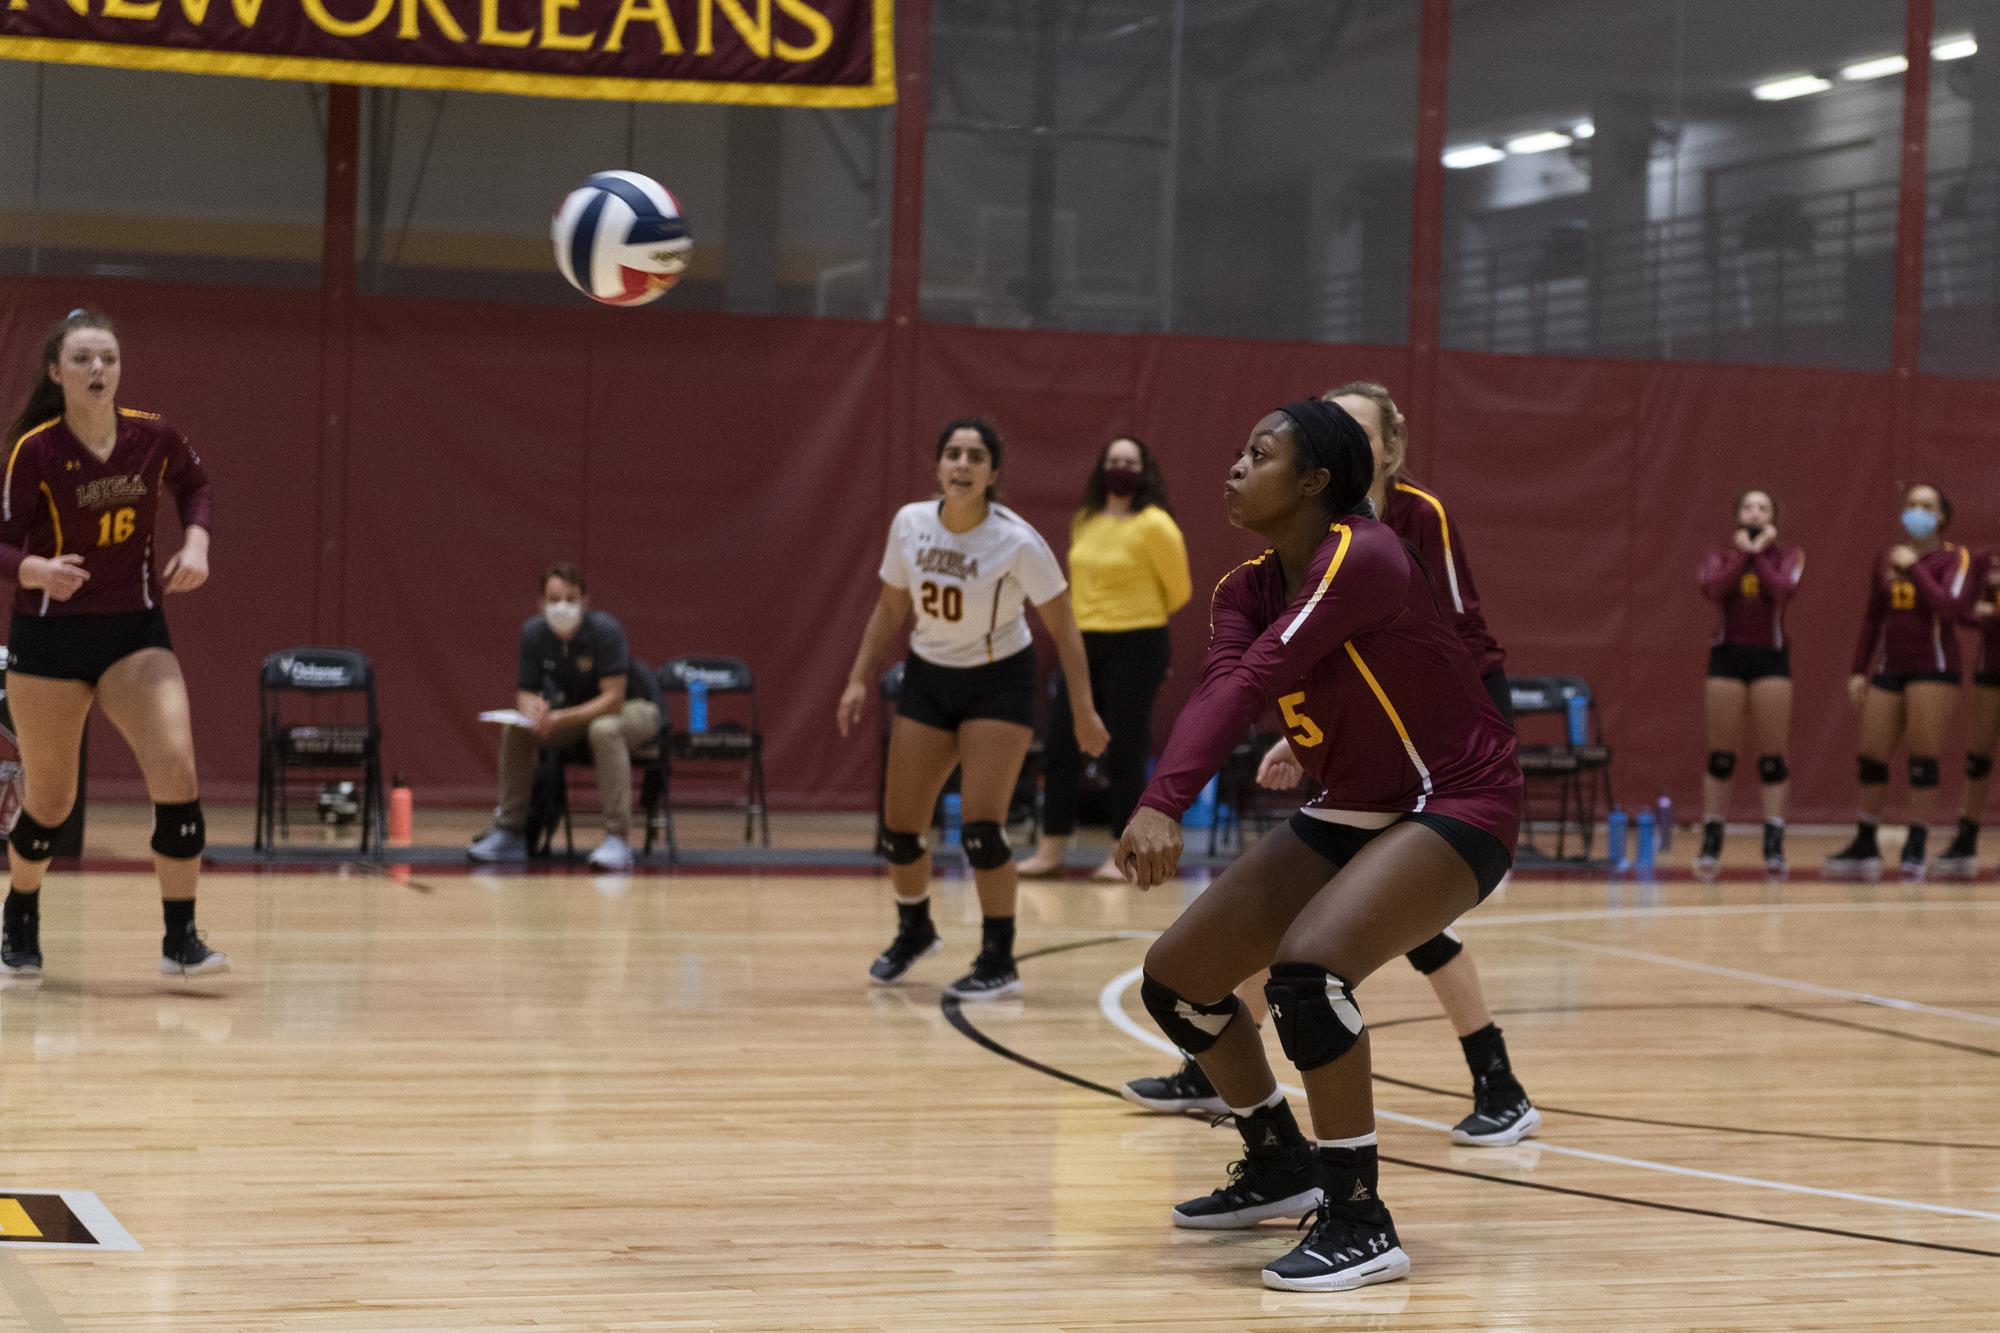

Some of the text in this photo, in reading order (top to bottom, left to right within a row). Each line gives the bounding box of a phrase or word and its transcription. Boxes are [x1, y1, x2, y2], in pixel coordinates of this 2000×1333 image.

[76, 473, 147, 508] LOYOLA
[97, 506, 136, 546] 16
[921, 580, 963, 623] 20
[1278, 691, 1324, 748] 5
